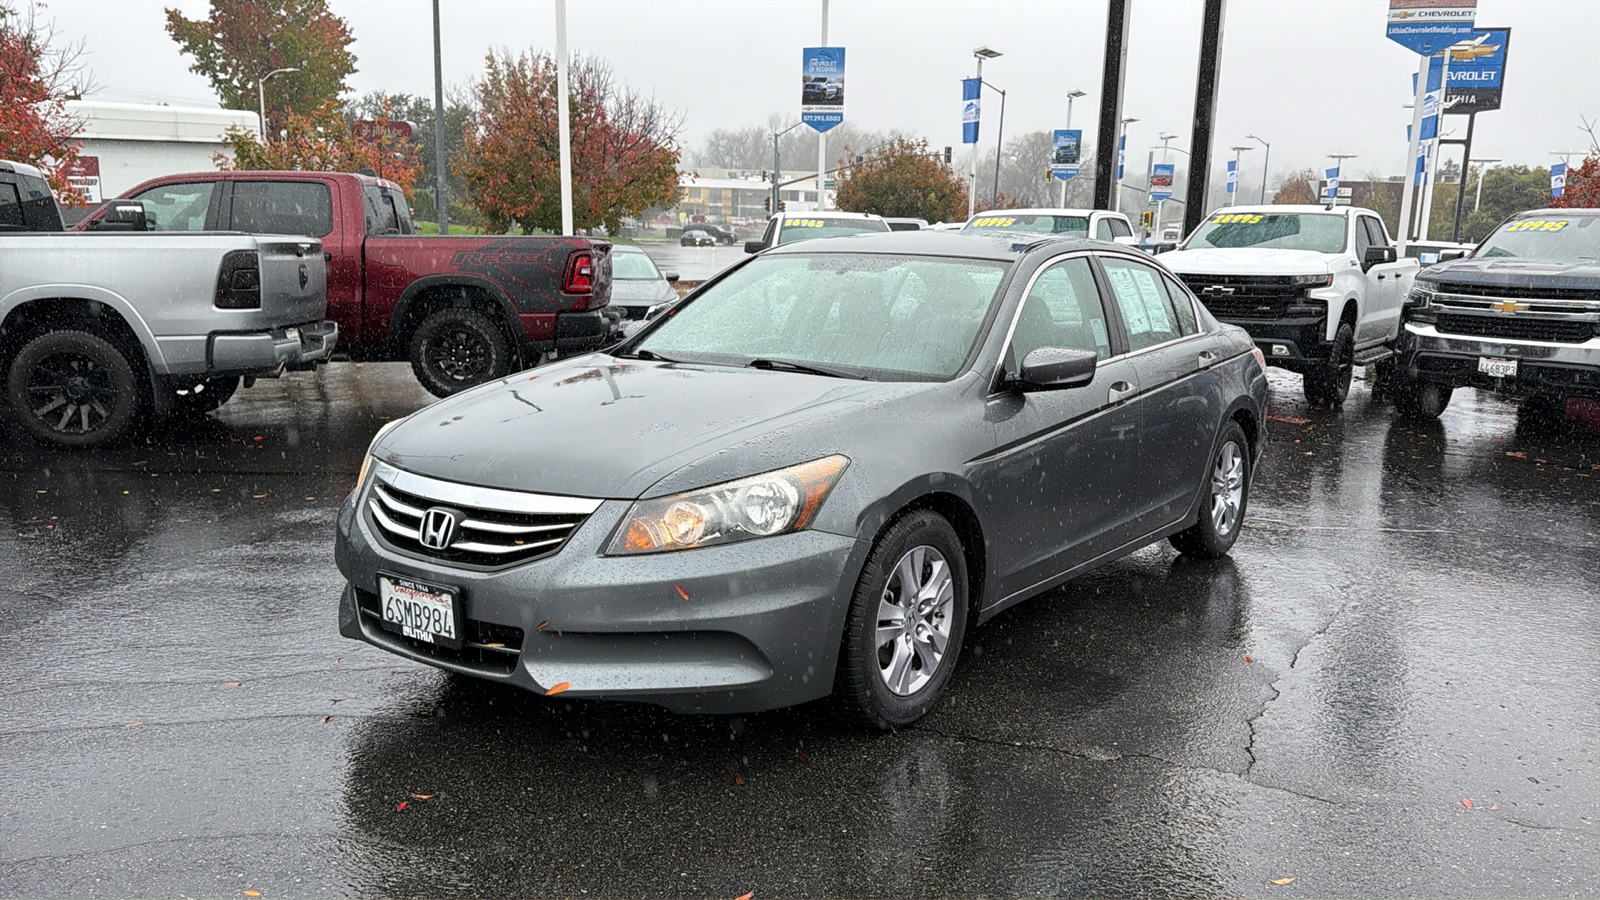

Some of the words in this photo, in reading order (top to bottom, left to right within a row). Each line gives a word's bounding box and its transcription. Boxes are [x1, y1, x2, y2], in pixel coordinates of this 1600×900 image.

[1388, 26, 1471, 35] LithiaChevroletRedding.com
[1446, 71, 1497, 81] EVROLET
[1446, 94, 1476, 104] ITHIA
[1211, 214, 1264, 224] 28995
[1506, 220, 1568, 232] 29995
[399, 579, 415, 590] SINCE
[385, 596, 452, 637] 6SMB984
